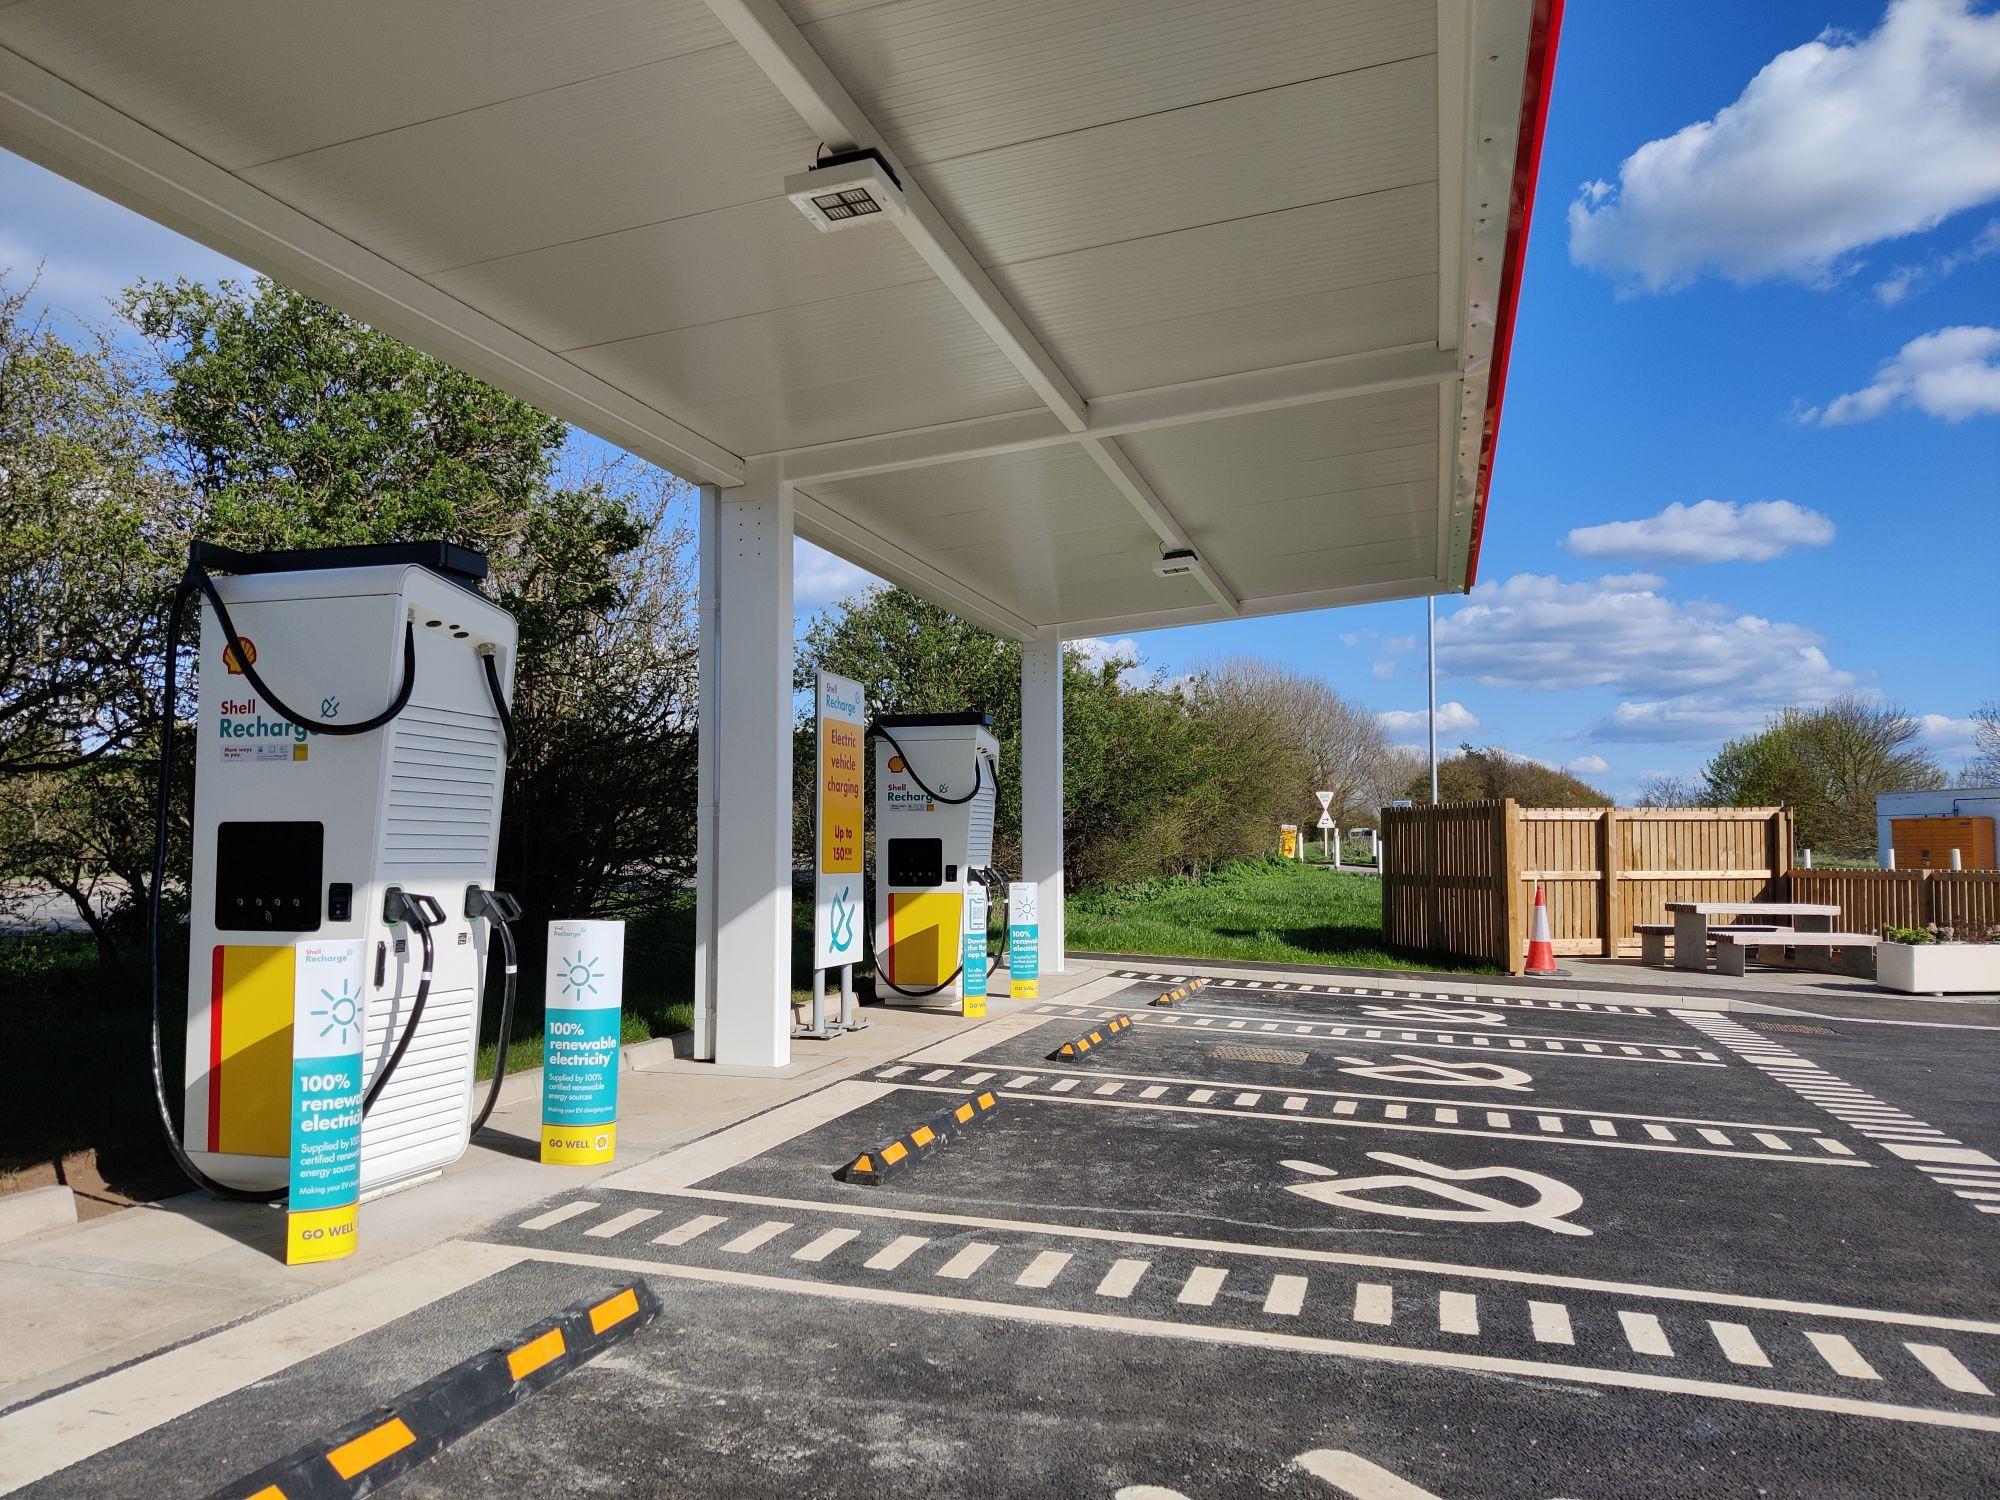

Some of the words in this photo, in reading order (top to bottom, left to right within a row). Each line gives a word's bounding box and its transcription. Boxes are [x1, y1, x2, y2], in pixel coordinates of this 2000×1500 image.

[826, 682, 838, 694] Shell
[221, 699, 256, 715] Shell
[826, 694, 856, 717] Recharge
[219, 716, 319, 742] Recharg
[831, 729, 856, 749] Electric
[831, 752, 856, 771] vehicle
[827, 776, 859, 798] charging
[887, 791, 936, 803] Recharg
[834, 825, 845, 842] Up
[845, 826, 853, 839] to
[833, 846, 845, 861] 150
[1012, 930, 1031, 938] 100%
[305, 954, 347, 963] Recharge
[549, 1022, 585, 1036] 100%
[549, 1036, 617, 1051] renewable
[300, 1073, 351, 1093] 100%
[548, 1073, 574, 1083] Supplied
[575, 1073, 584, 1083] by
[584, 1073, 603, 1081] 100%
[548, 1083, 571, 1091] certified
[571, 1082, 605, 1091] renewable
[548, 1093, 568, 1102] energy
[569, 1093, 593, 1101] sources
[301, 1140, 339, 1155] Supplied
[340, 1138, 350, 1151] by
[549, 1139, 563, 1148] GO
[565, 1140, 590, 1149] WELL
[300, 1152, 336, 1166] certified
[300, 1167, 331, 1179] energy
[332, 1163, 356, 1175] sources
[300, 1186, 326, 1195] Making
[326, 1184, 341, 1194] your
[341, 1180, 350, 1190] EV
[302, 1228, 324, 1240] GO
[328, 1222, 354, 1237] WELL
